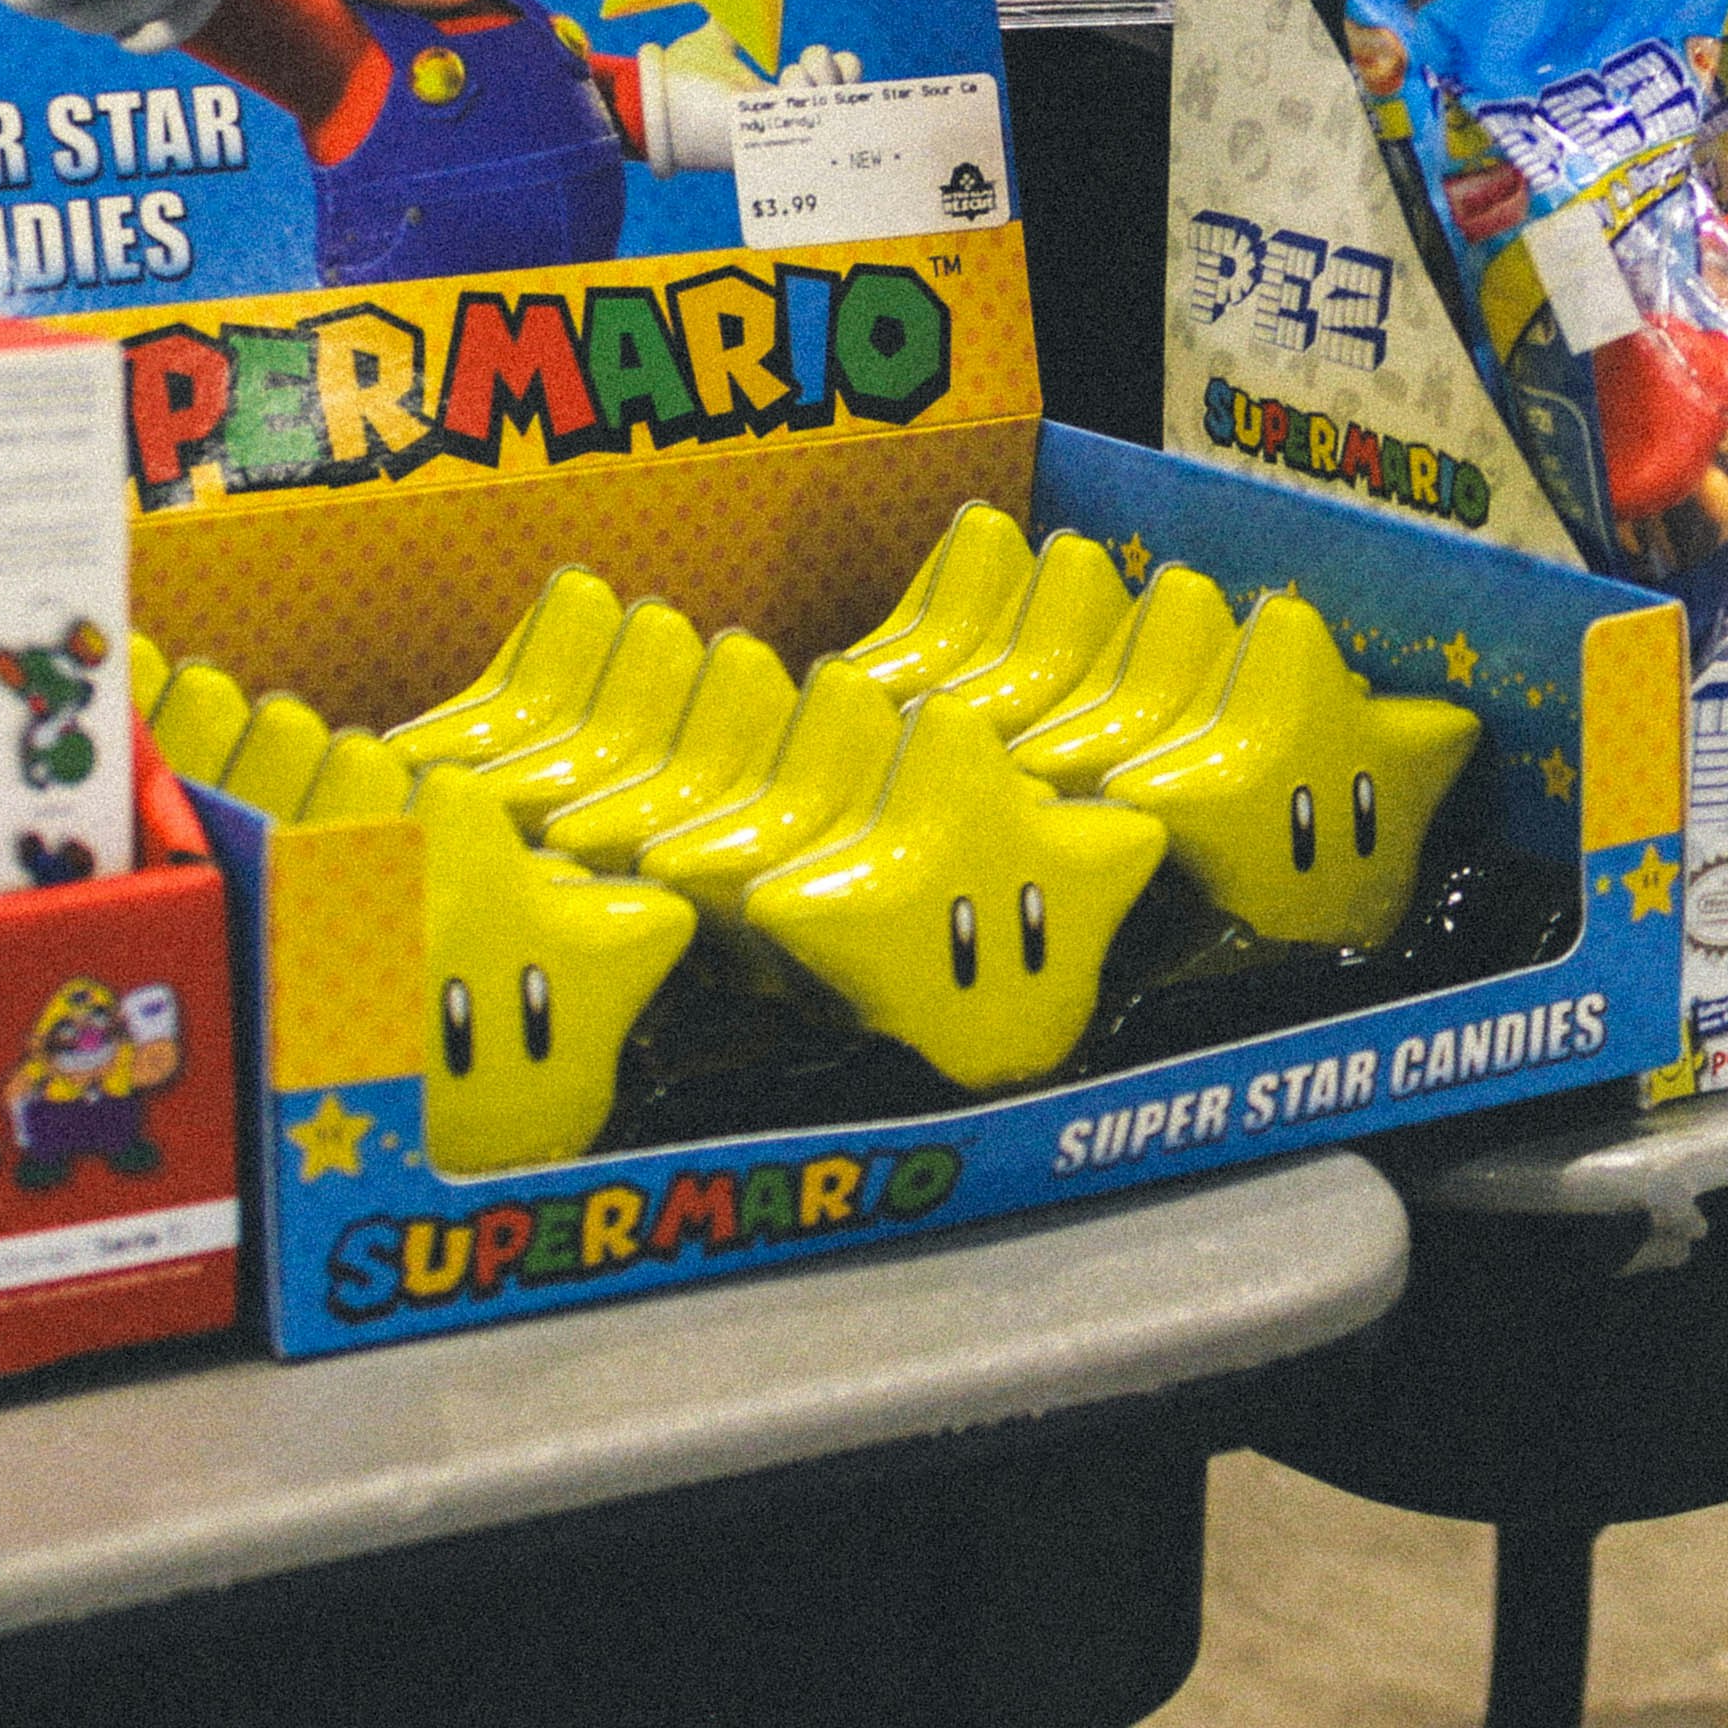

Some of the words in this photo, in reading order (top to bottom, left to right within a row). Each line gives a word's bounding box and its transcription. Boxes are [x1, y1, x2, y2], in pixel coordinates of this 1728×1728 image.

[50, 83, 249, 186] STAR
[834, 92, 872, 107] Super
[881, 87, 912, 101] Star
[921, 84, 952, 98] Sour
[849, 152, 882, 169] NEW
[751, 194, 817, 219] $3.99
[1187, 209, 1394, 373] PEZ
[126, 300, 444, 513] PER
[440, 263, 955, 469] MARIO
[1203, 376, 1339, 477] SUPER
[1334, 422, 1490, 531] MARIO
[1052, 1080, 1240, 1178] SUPER
[1242, 1048, 1385, 1130] STAR
[1385, 993, 1610, 1092] CANDIES
[326, 1187, 645, 1325] SUPER
[649, 1147, 962, 1262] MARIO
